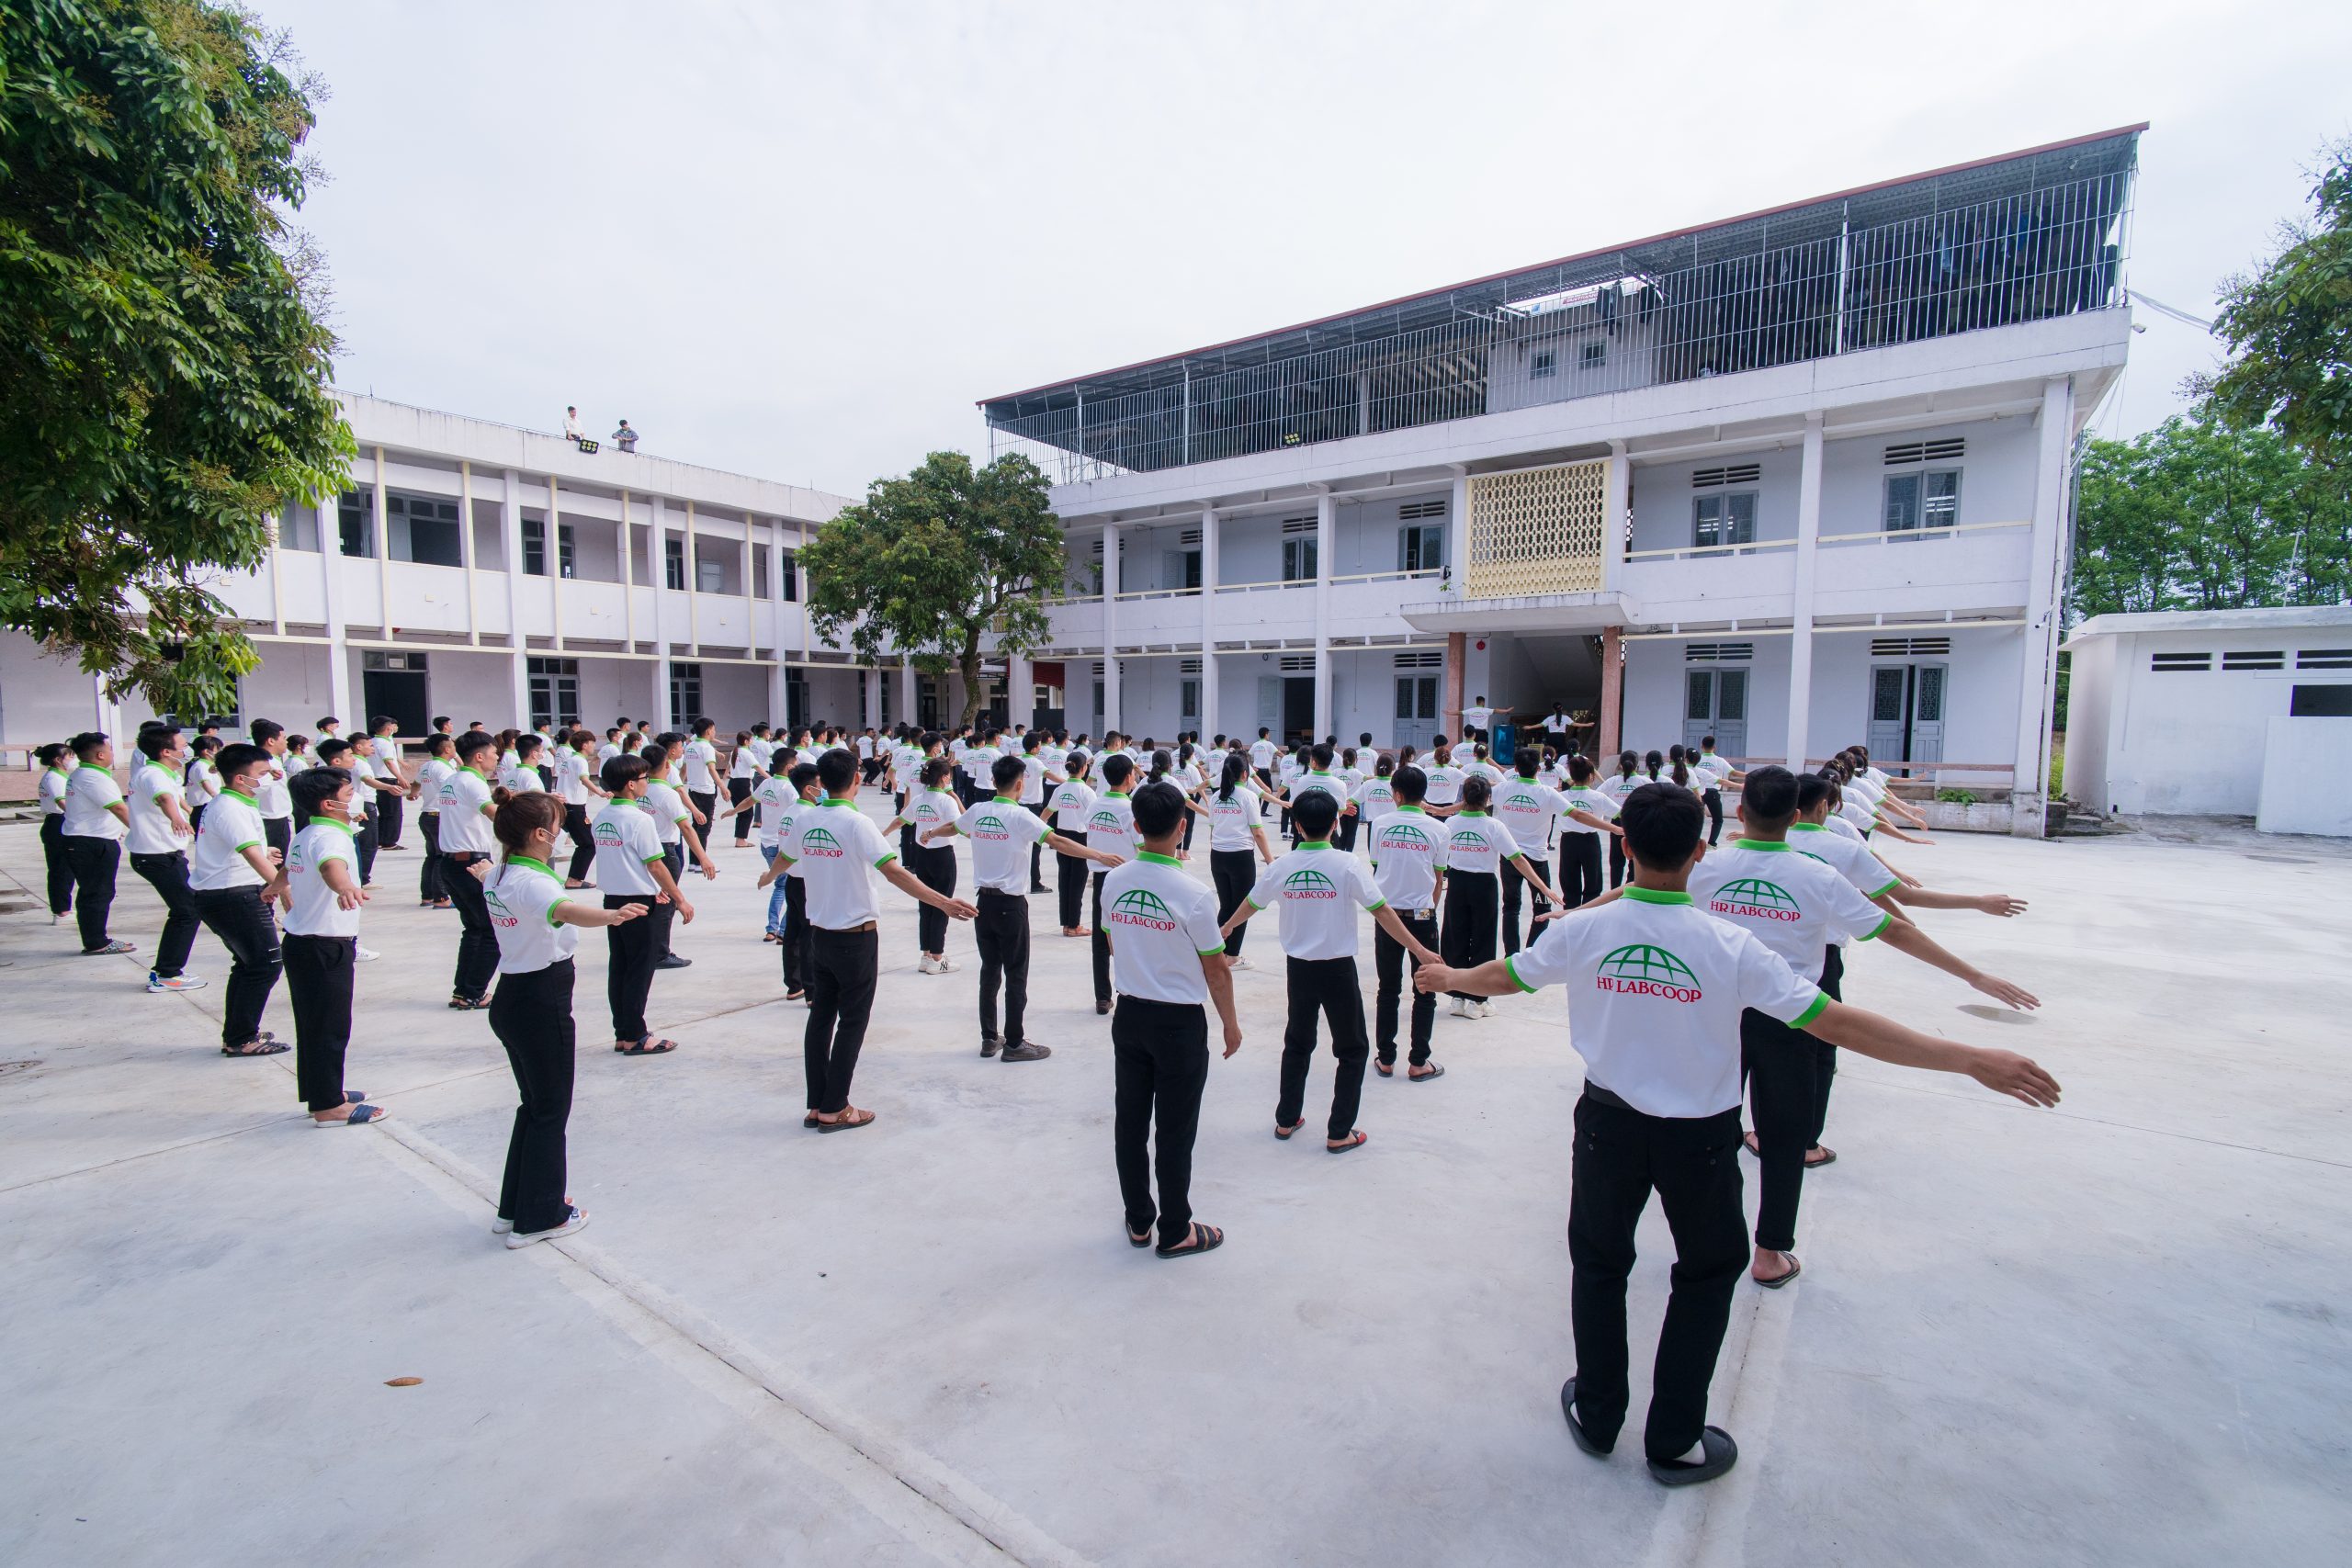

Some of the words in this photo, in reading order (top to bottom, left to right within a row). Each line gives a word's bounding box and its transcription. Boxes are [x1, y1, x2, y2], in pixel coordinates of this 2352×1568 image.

[1391, 841, 1430, 852] LABCOOP
[1294, 890, 1337, 899] LABCOOP
[1710, 900, 1729, 913] HR
[1730, 904, 1801, 922] LABCOOP
[1124, 914, 1176, 931] LABCOOP
[1616, 979, 1702, 1003] LABCOOP
